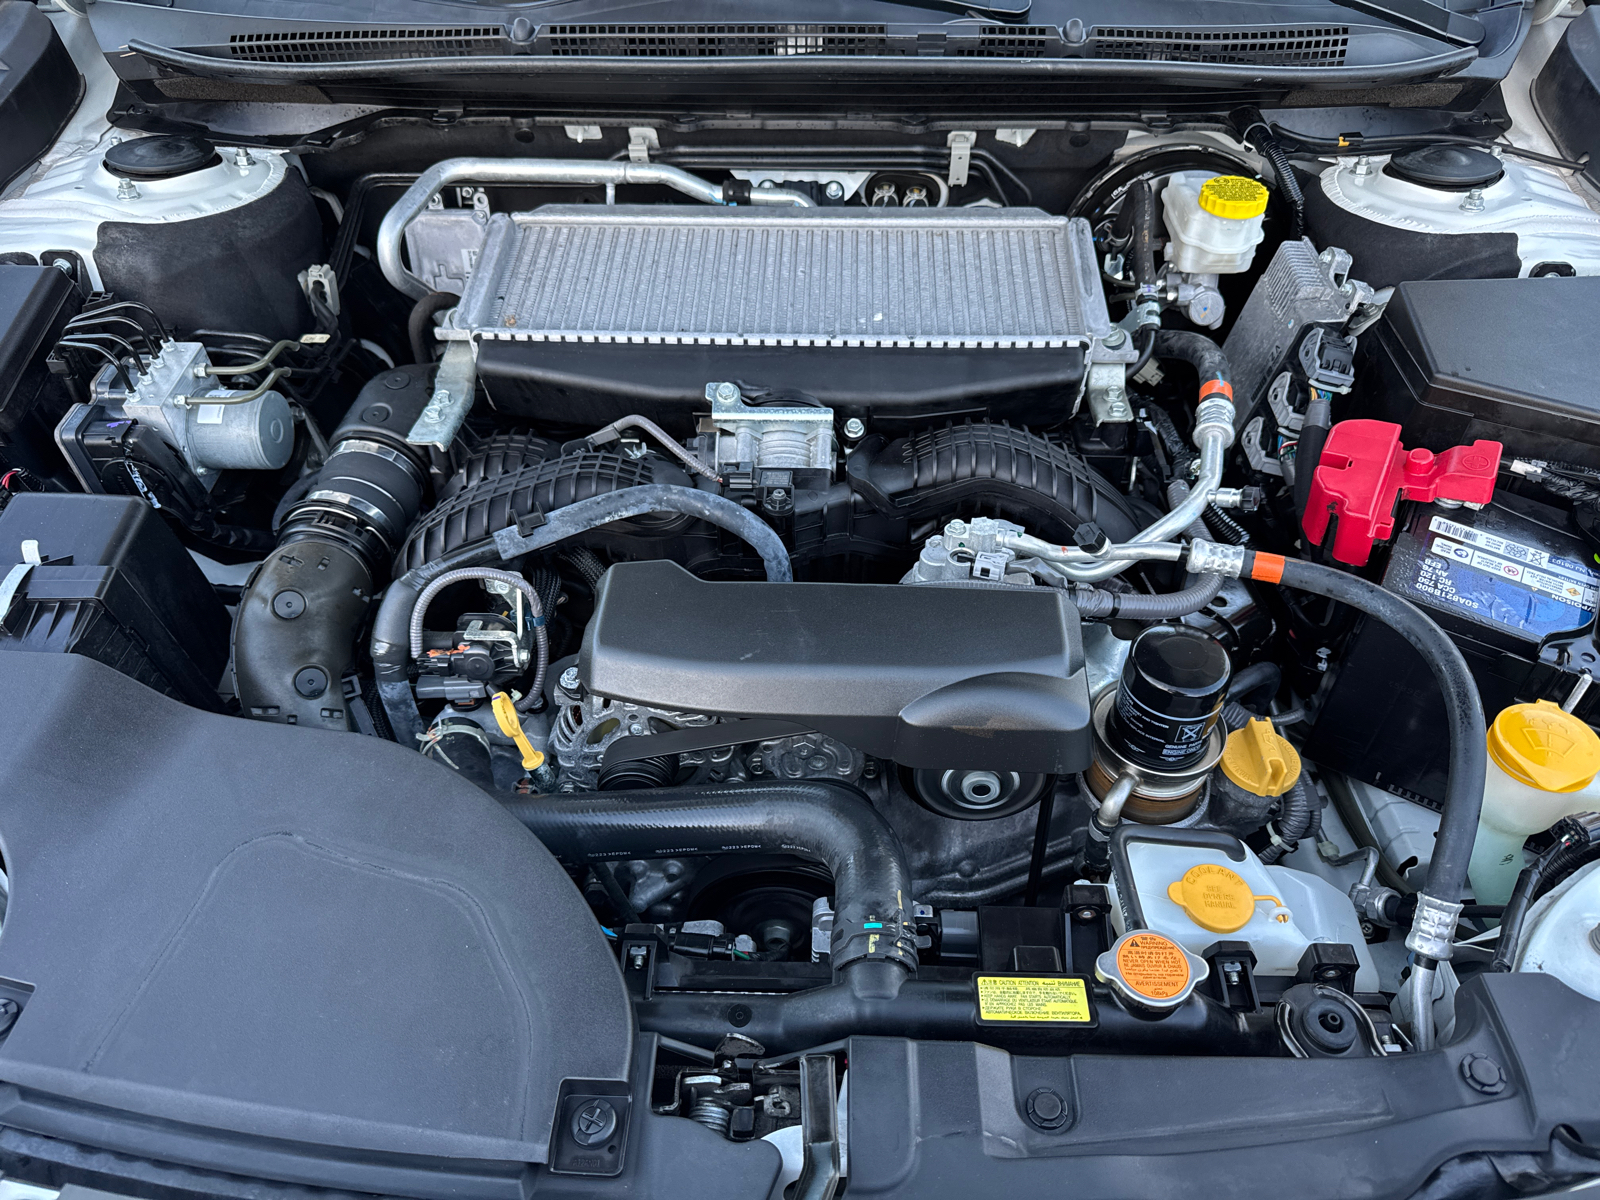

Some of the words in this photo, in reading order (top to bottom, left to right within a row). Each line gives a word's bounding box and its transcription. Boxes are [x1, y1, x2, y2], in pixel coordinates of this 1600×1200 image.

[1424, 558, 1442, 568] EFB
[1420, 570, 1436, 580] 120
[1436, 569, 1448, 577] Ah
[1418, 576, 1435, 586] 750
[1438, 577, 1452, 585] RC
[1436, 583, 1456, 593] CCA
[1186, 866, 1244, 885] COOLANT
